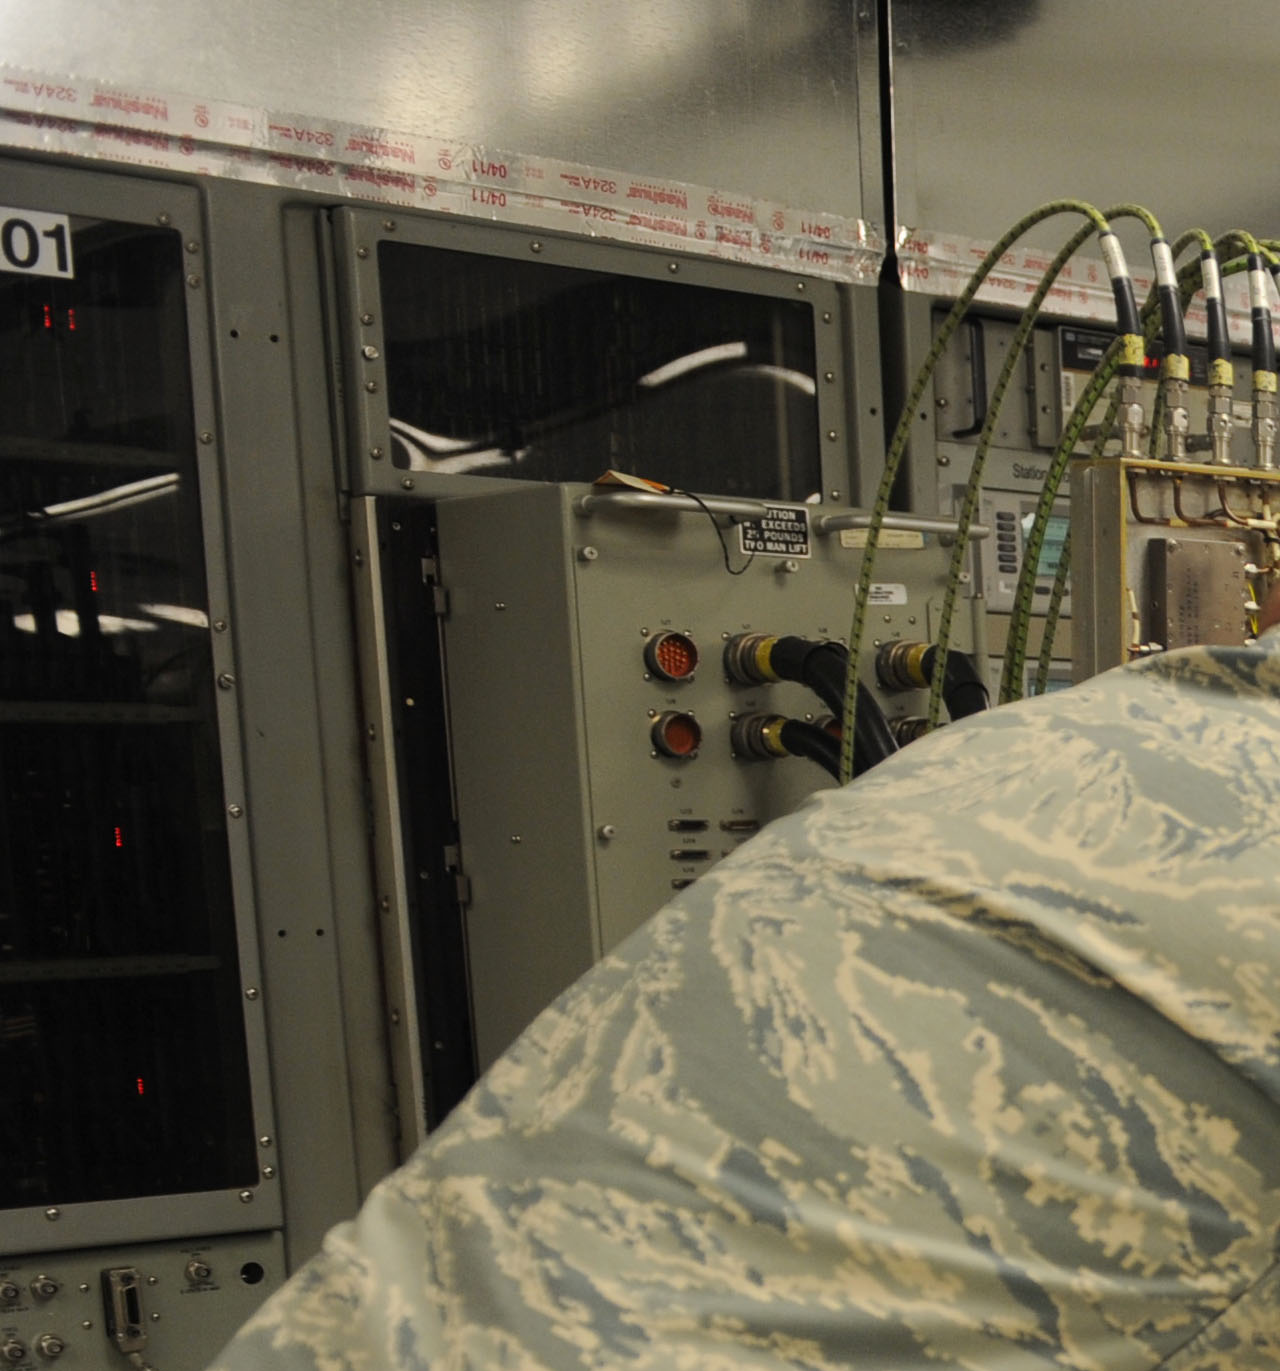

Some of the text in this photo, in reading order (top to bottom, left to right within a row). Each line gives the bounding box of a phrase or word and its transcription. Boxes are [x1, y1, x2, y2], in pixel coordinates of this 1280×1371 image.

[32, 82, 77, 102] 324A
[293, 127, 334, 146] 324A
[471, 159, 507, 178] 04/11
[471, 187, 506, 207] 04/11
[581, 175, 688, 211] Nashua 324A
[581, 202, 617, 221] 324A
[799, 220, 831, 240] 04/11
[1, 217, 68, 272] 01
[761, 519, 806, 531] EXCEEDS
[764, 530, 804, 543] POUNDS
[766, 542, 787, 552] MAN
[788, 543, 807, 553] LIFT
